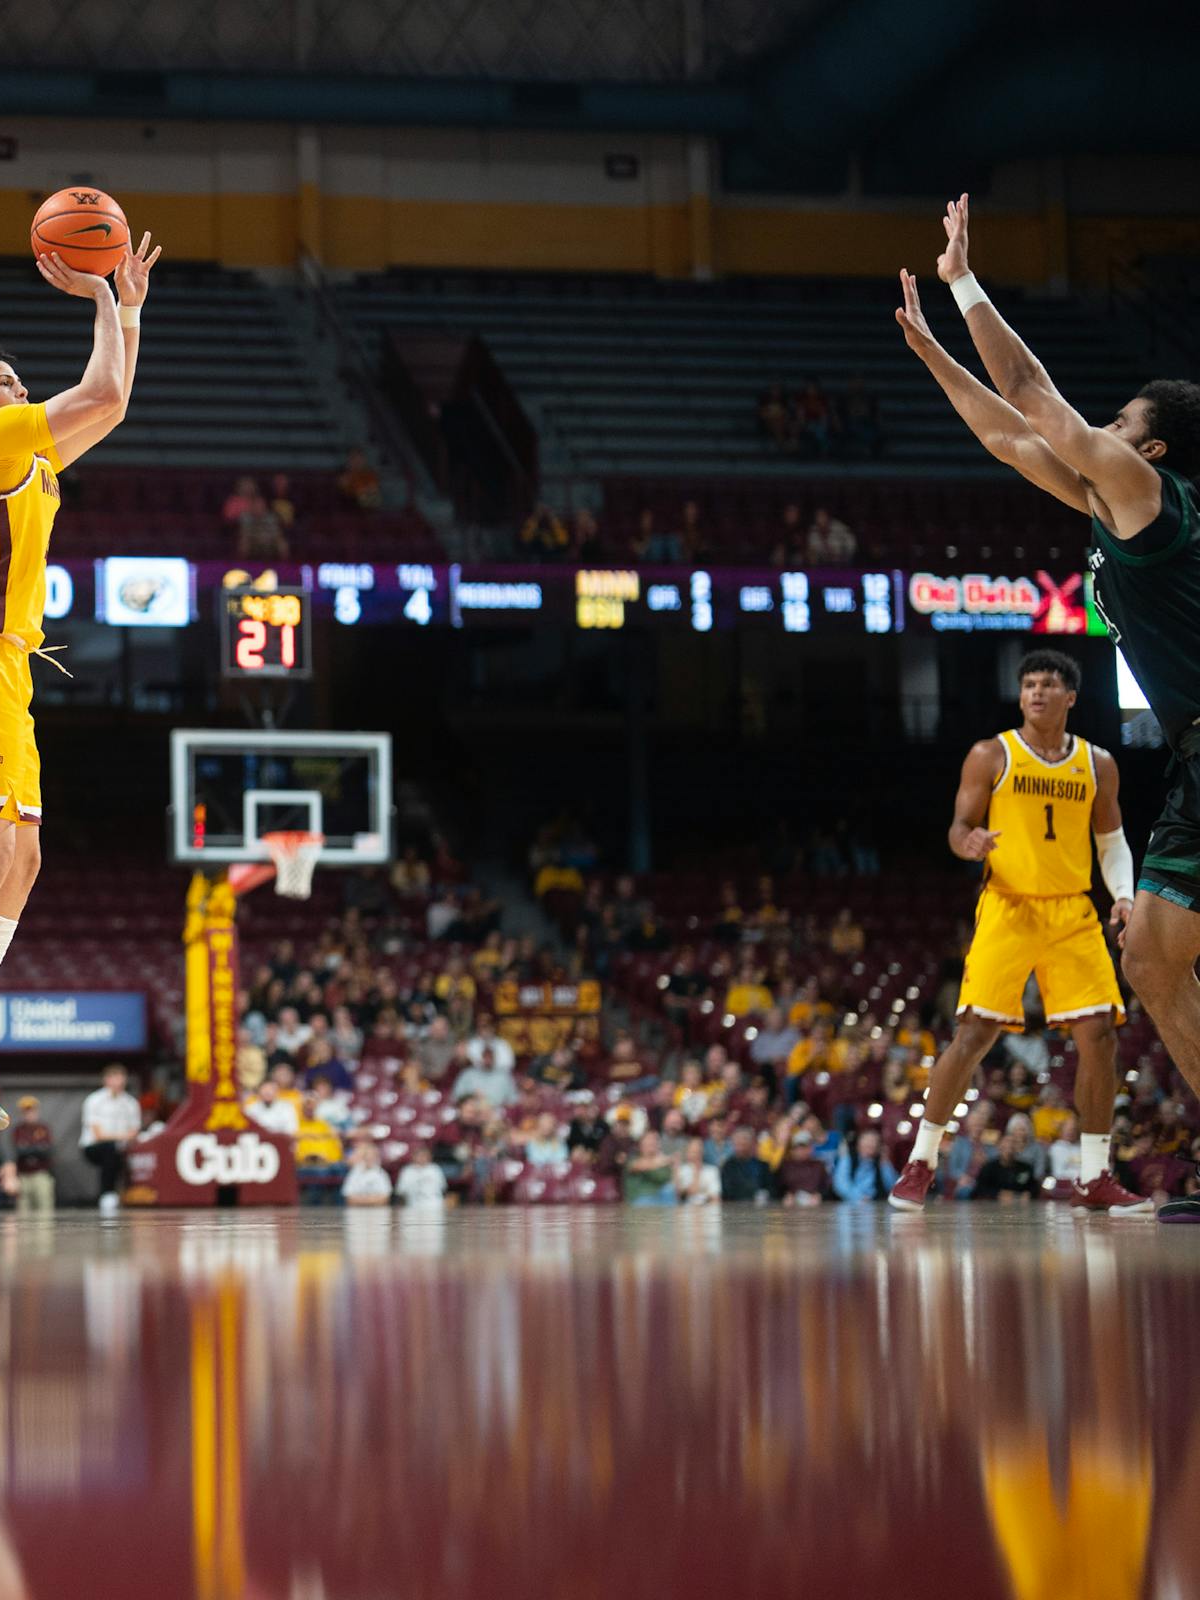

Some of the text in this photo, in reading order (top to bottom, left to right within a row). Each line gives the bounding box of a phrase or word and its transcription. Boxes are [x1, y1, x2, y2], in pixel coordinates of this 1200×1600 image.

[403, 586, 432, 626] 4
[960, 573, 1041, 614] Dutch
[235, 618, 295, 669] 21
[1012, 775, 1087, 803] MINNESOTA
[1043, 803, 1057, 841] 1
[10, 998, 77, 1021] United
[9, 1019, 116, 1042] Healthcare
[175, 1132, 280, 1186] Cub
